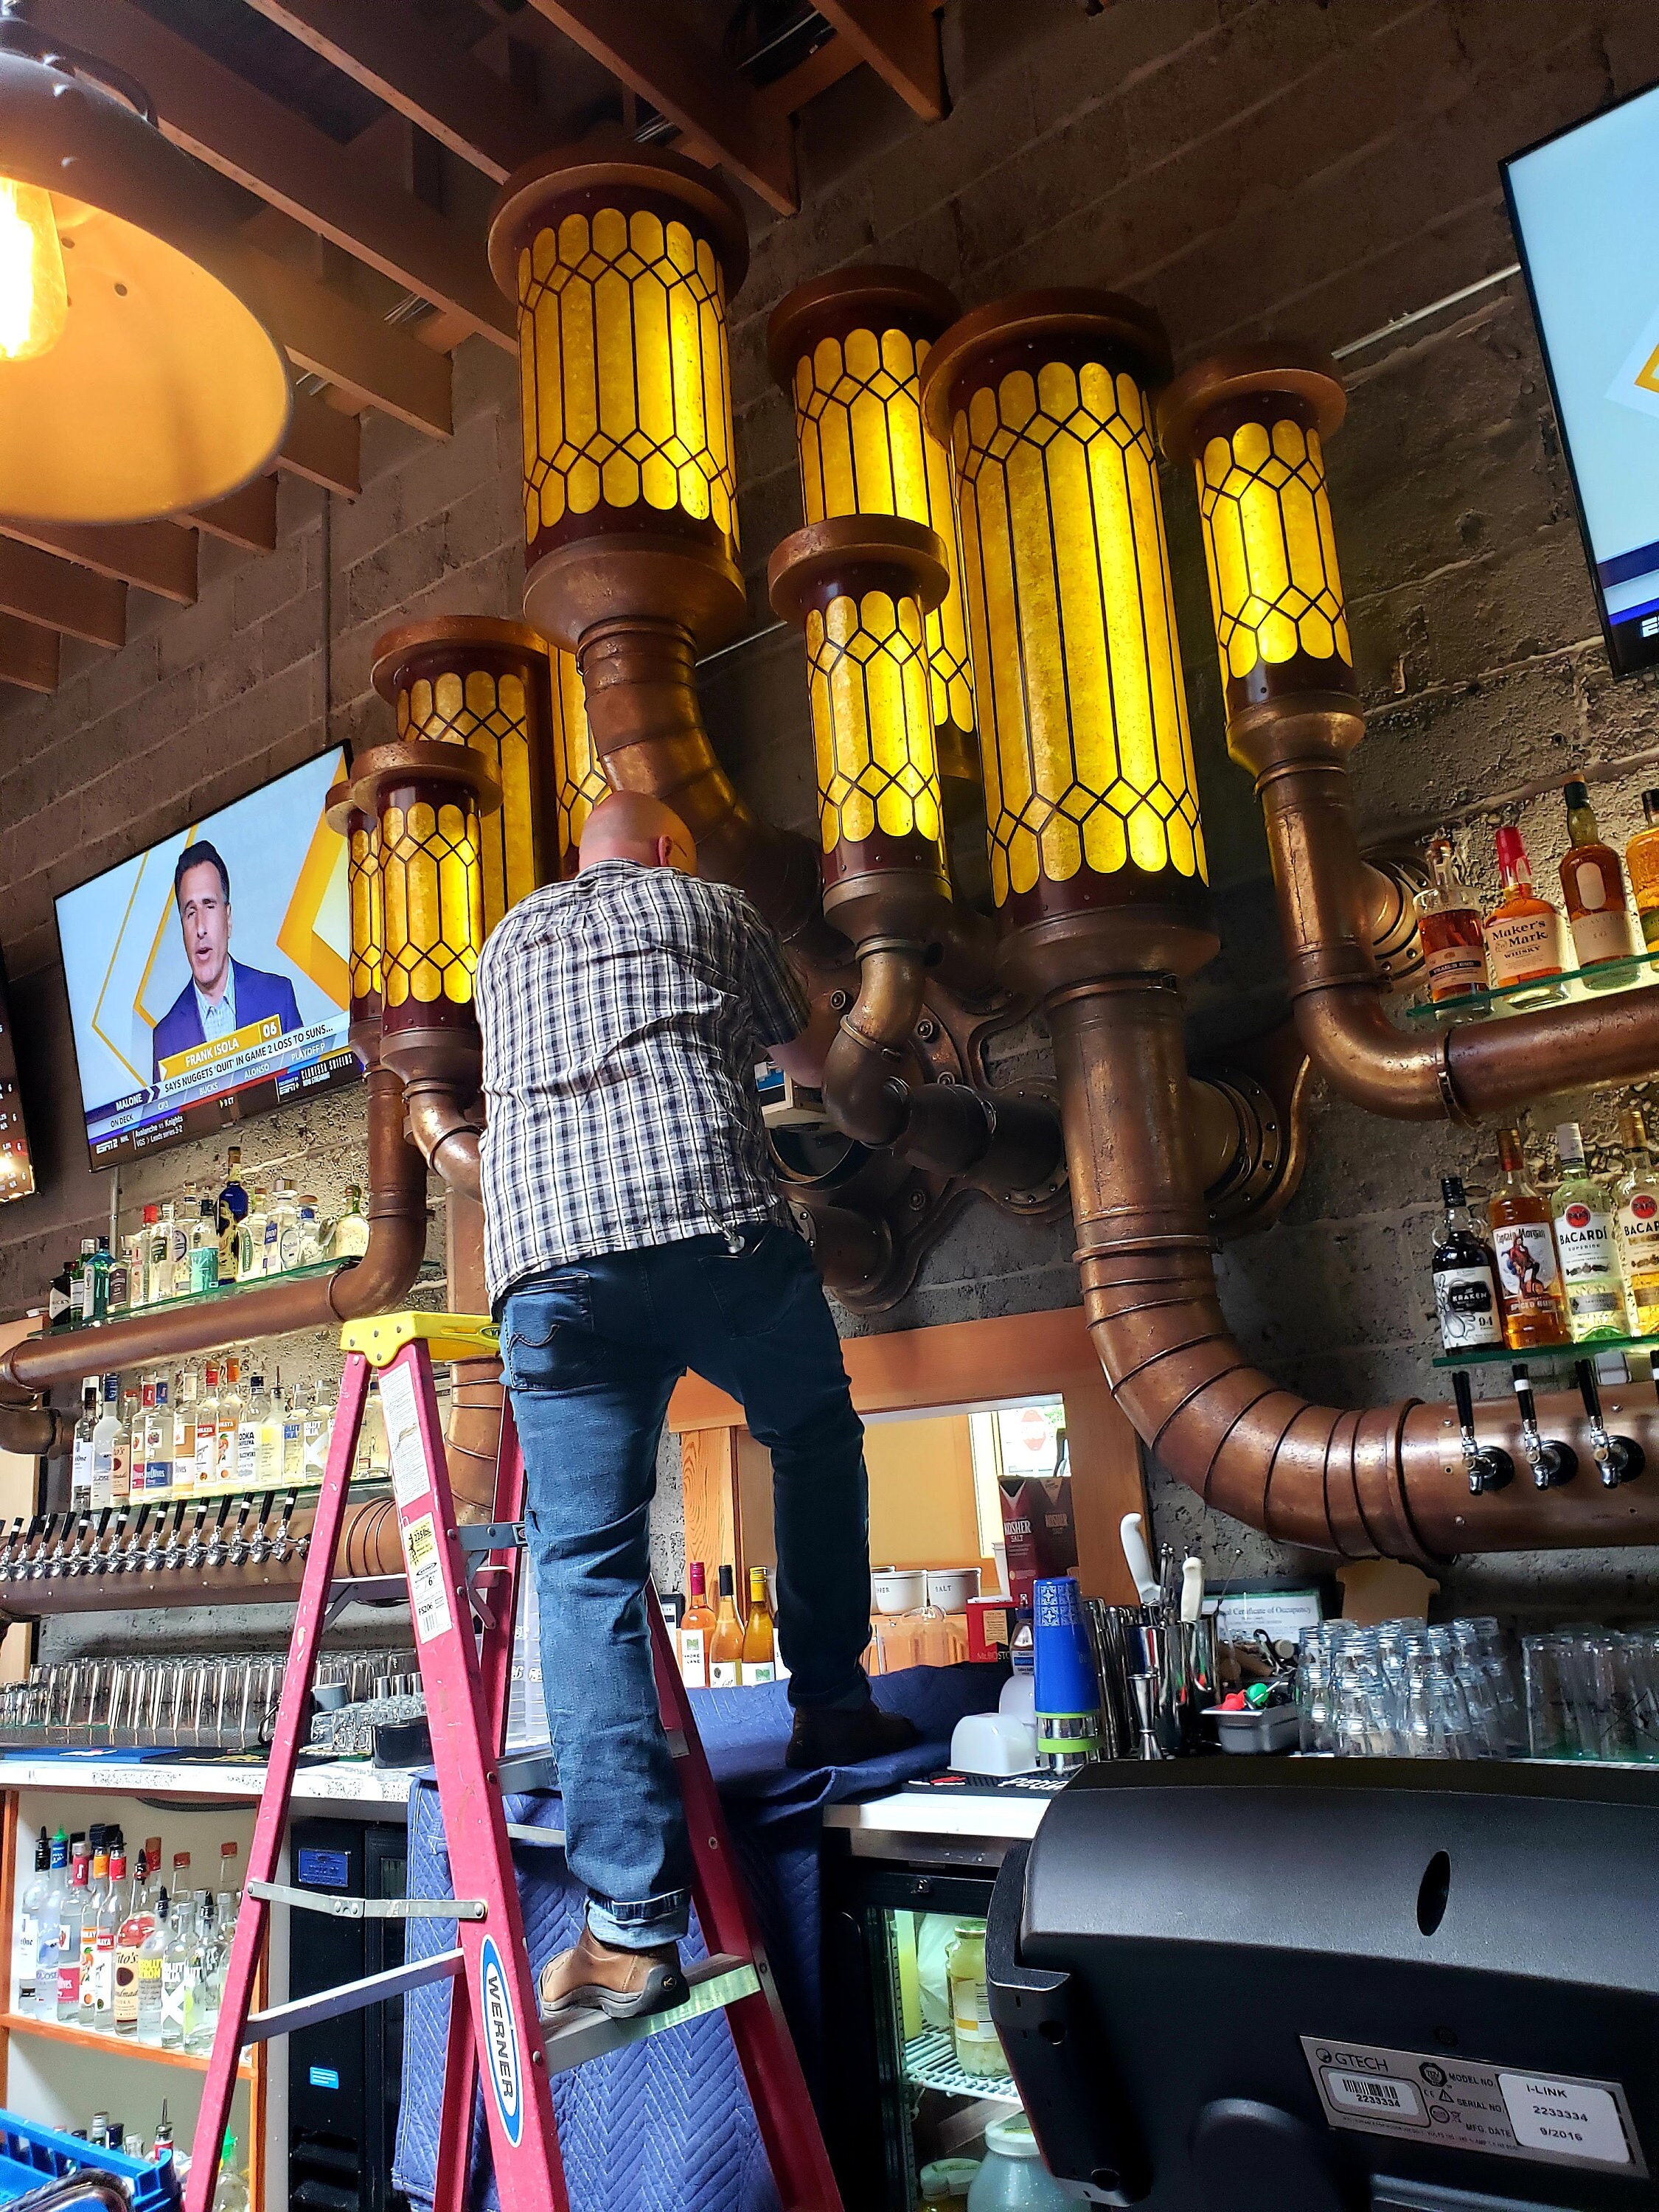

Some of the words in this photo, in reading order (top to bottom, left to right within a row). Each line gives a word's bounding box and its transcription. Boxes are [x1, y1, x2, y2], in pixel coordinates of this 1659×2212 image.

[1492, 920, 1546, 941] Maker's
[1509, 931, 1549, 947] Mark
[1504, 945, 1540, 959] WHISKY
[185, 1047, 213, 1067] FRANK
[214, 1037, 240, 1056] ISOLA
[262, 1022, 277, 1037] 06
[164, 1079, 181, 1093] SAYS
[182, 1067, 213, 1087] NUGGETS
[214, 1060, 234, 1073] 'QUIT'
[236, 1054, 244, 1065] IN
[245, 1046, 267, 1062] GAME
[268, 1045, 273, 1054] 2
[274, 1037, 292, 1049] LOSS
[293, 1033, 304, 1044] TO
[111, 1119, 119, 1128] ON
[119, 1113, 133, 1124] DECK
[158, 1100, 169, 1110] CP3
[198, 1082, 218, 1096] BUCKS
[244, 1063, 270, 1079] ALONSO
[291, 1044, 320, 1062] PLAYOFF
[320, 1043, 325, 1052] P
[116, 1093, 143, 1111] MALONE
[164, 1115, 183, 1127] Knights
[1519, 1228, 1546, 1239] Morgan
[1452, 1293, 1487, 1302] KRAKEN
[1004, 1520, 1032, 1536] KOSHER
[1010, 1534, 1023, 1543] SALT
[935, 1585, 952, 1593] SALT
[418, 1601, 434, 1616] FS206
[1233, 1607, 1266, 1615] Certificate
[1267, 1605, 1275, 1614] of
[1276, 1606, 1311, 1615] Occupancy
[487, 1975, 513, 2098] WERNER
[1335, 2053, 1389, 2072] GTECH
[1448, 2073, 1479, 2085] MODEL
[1481, 2079, 1496, 2087] NO.
[1526, 2083, 1568, 2098] I-LINK
[1356, 2094, 1401, 2107] 2233334
[1456, 2098, 1487, 2110] SERIAL
[1489, 2104, 1505, 2113] NO.
[1533, 2105, 1588, 2122] 2233334
[1465, 2123, 1487, 2134] MFG.
[1488, 2128, 1512, 2138] DATE
